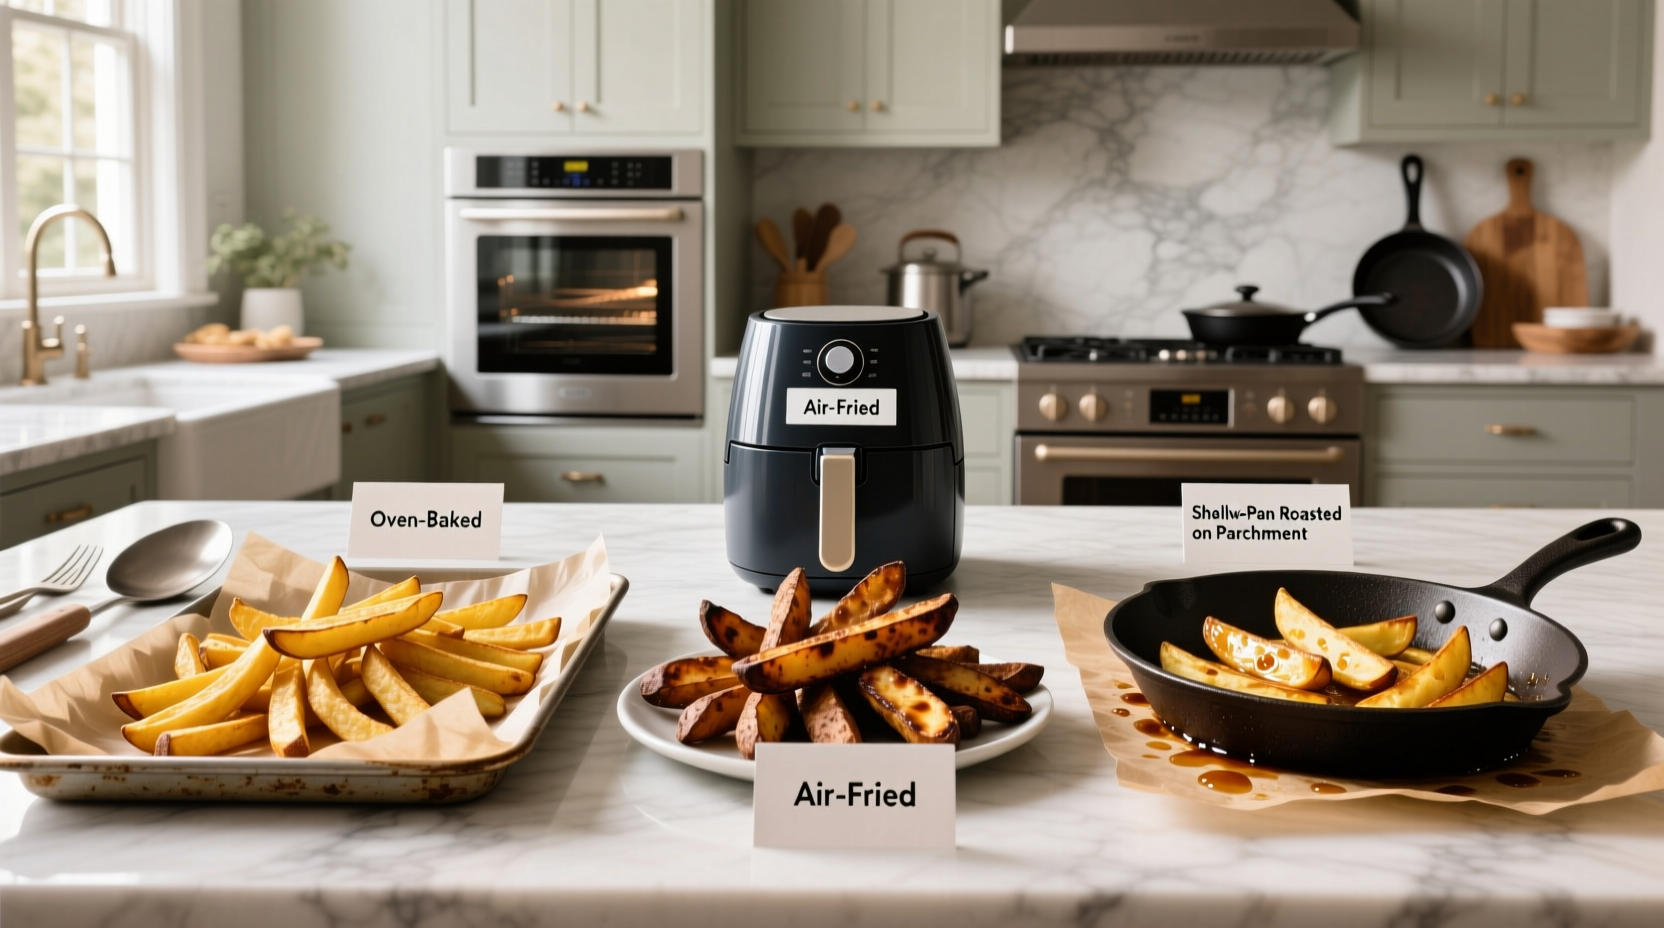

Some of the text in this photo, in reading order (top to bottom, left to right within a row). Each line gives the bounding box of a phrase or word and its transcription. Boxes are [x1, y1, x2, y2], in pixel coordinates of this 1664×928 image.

[803, 398, 880, 416] Air-Fried
[370, 509, 482, 529] Oven-Baked
[1279, 505, 1342, 522] Roasted
[1191, 528, 1212, 541] on
[793, 780, 916, 808] Air-Fried
